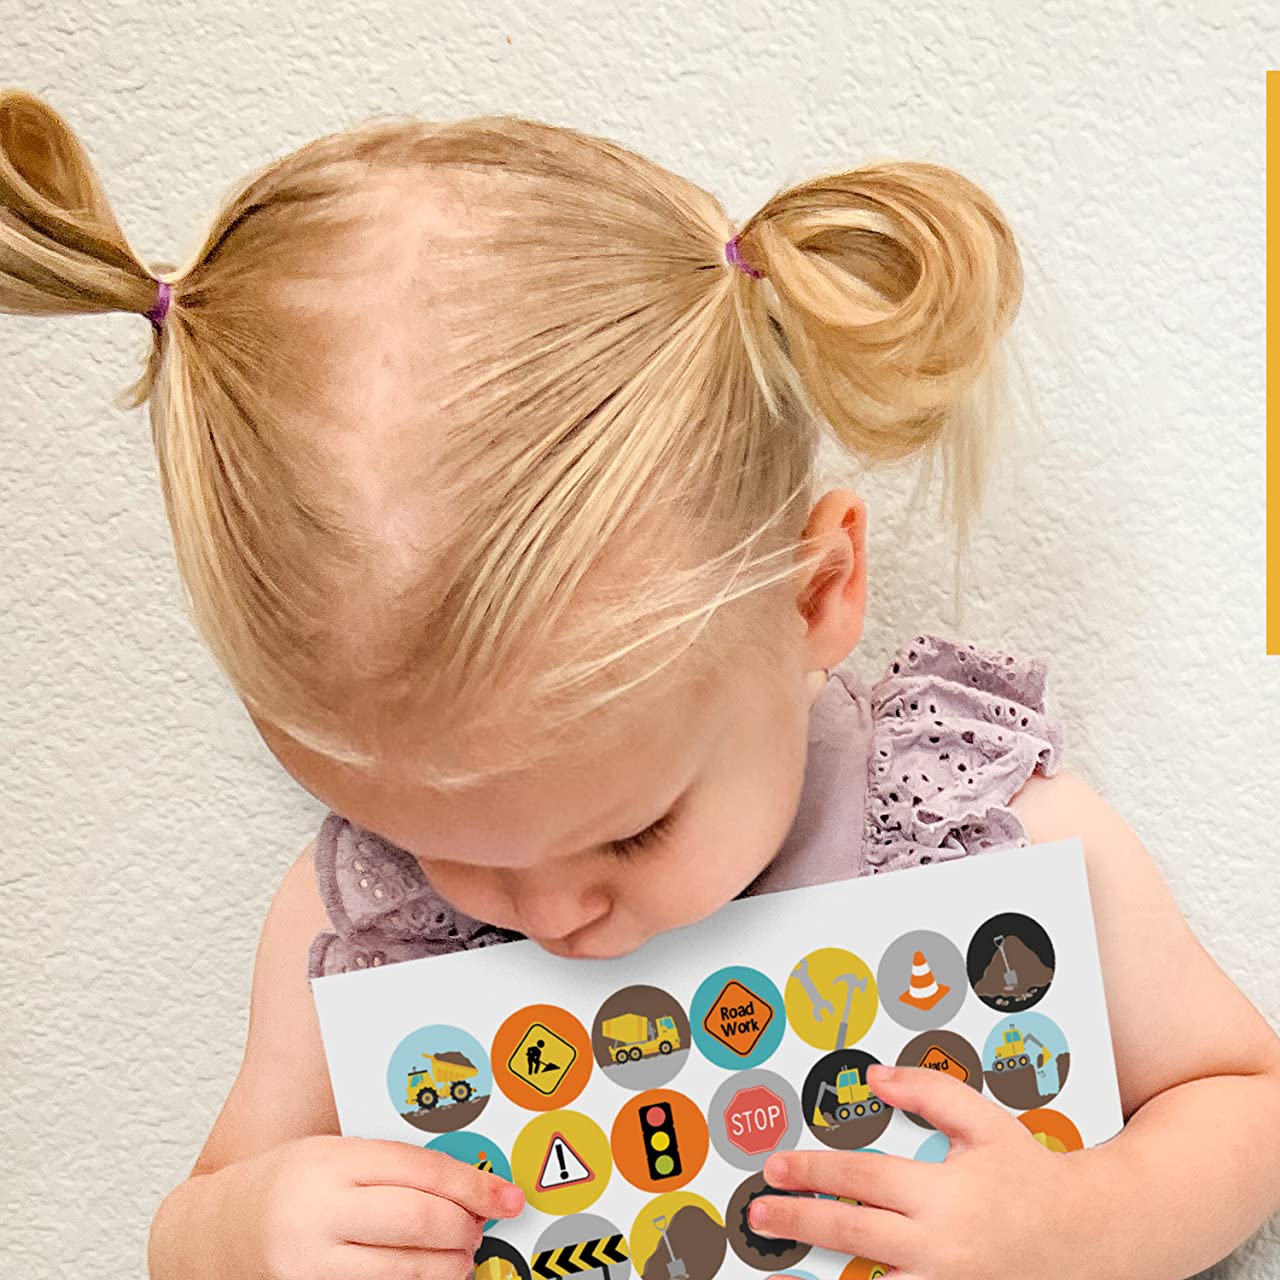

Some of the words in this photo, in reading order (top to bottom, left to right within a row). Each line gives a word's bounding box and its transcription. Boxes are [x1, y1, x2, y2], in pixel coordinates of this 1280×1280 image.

[720, 1001, 755, 1021] Road
[720, 1018, 760, 1037] Work
[731, 1105, 780, 1136] STOP
